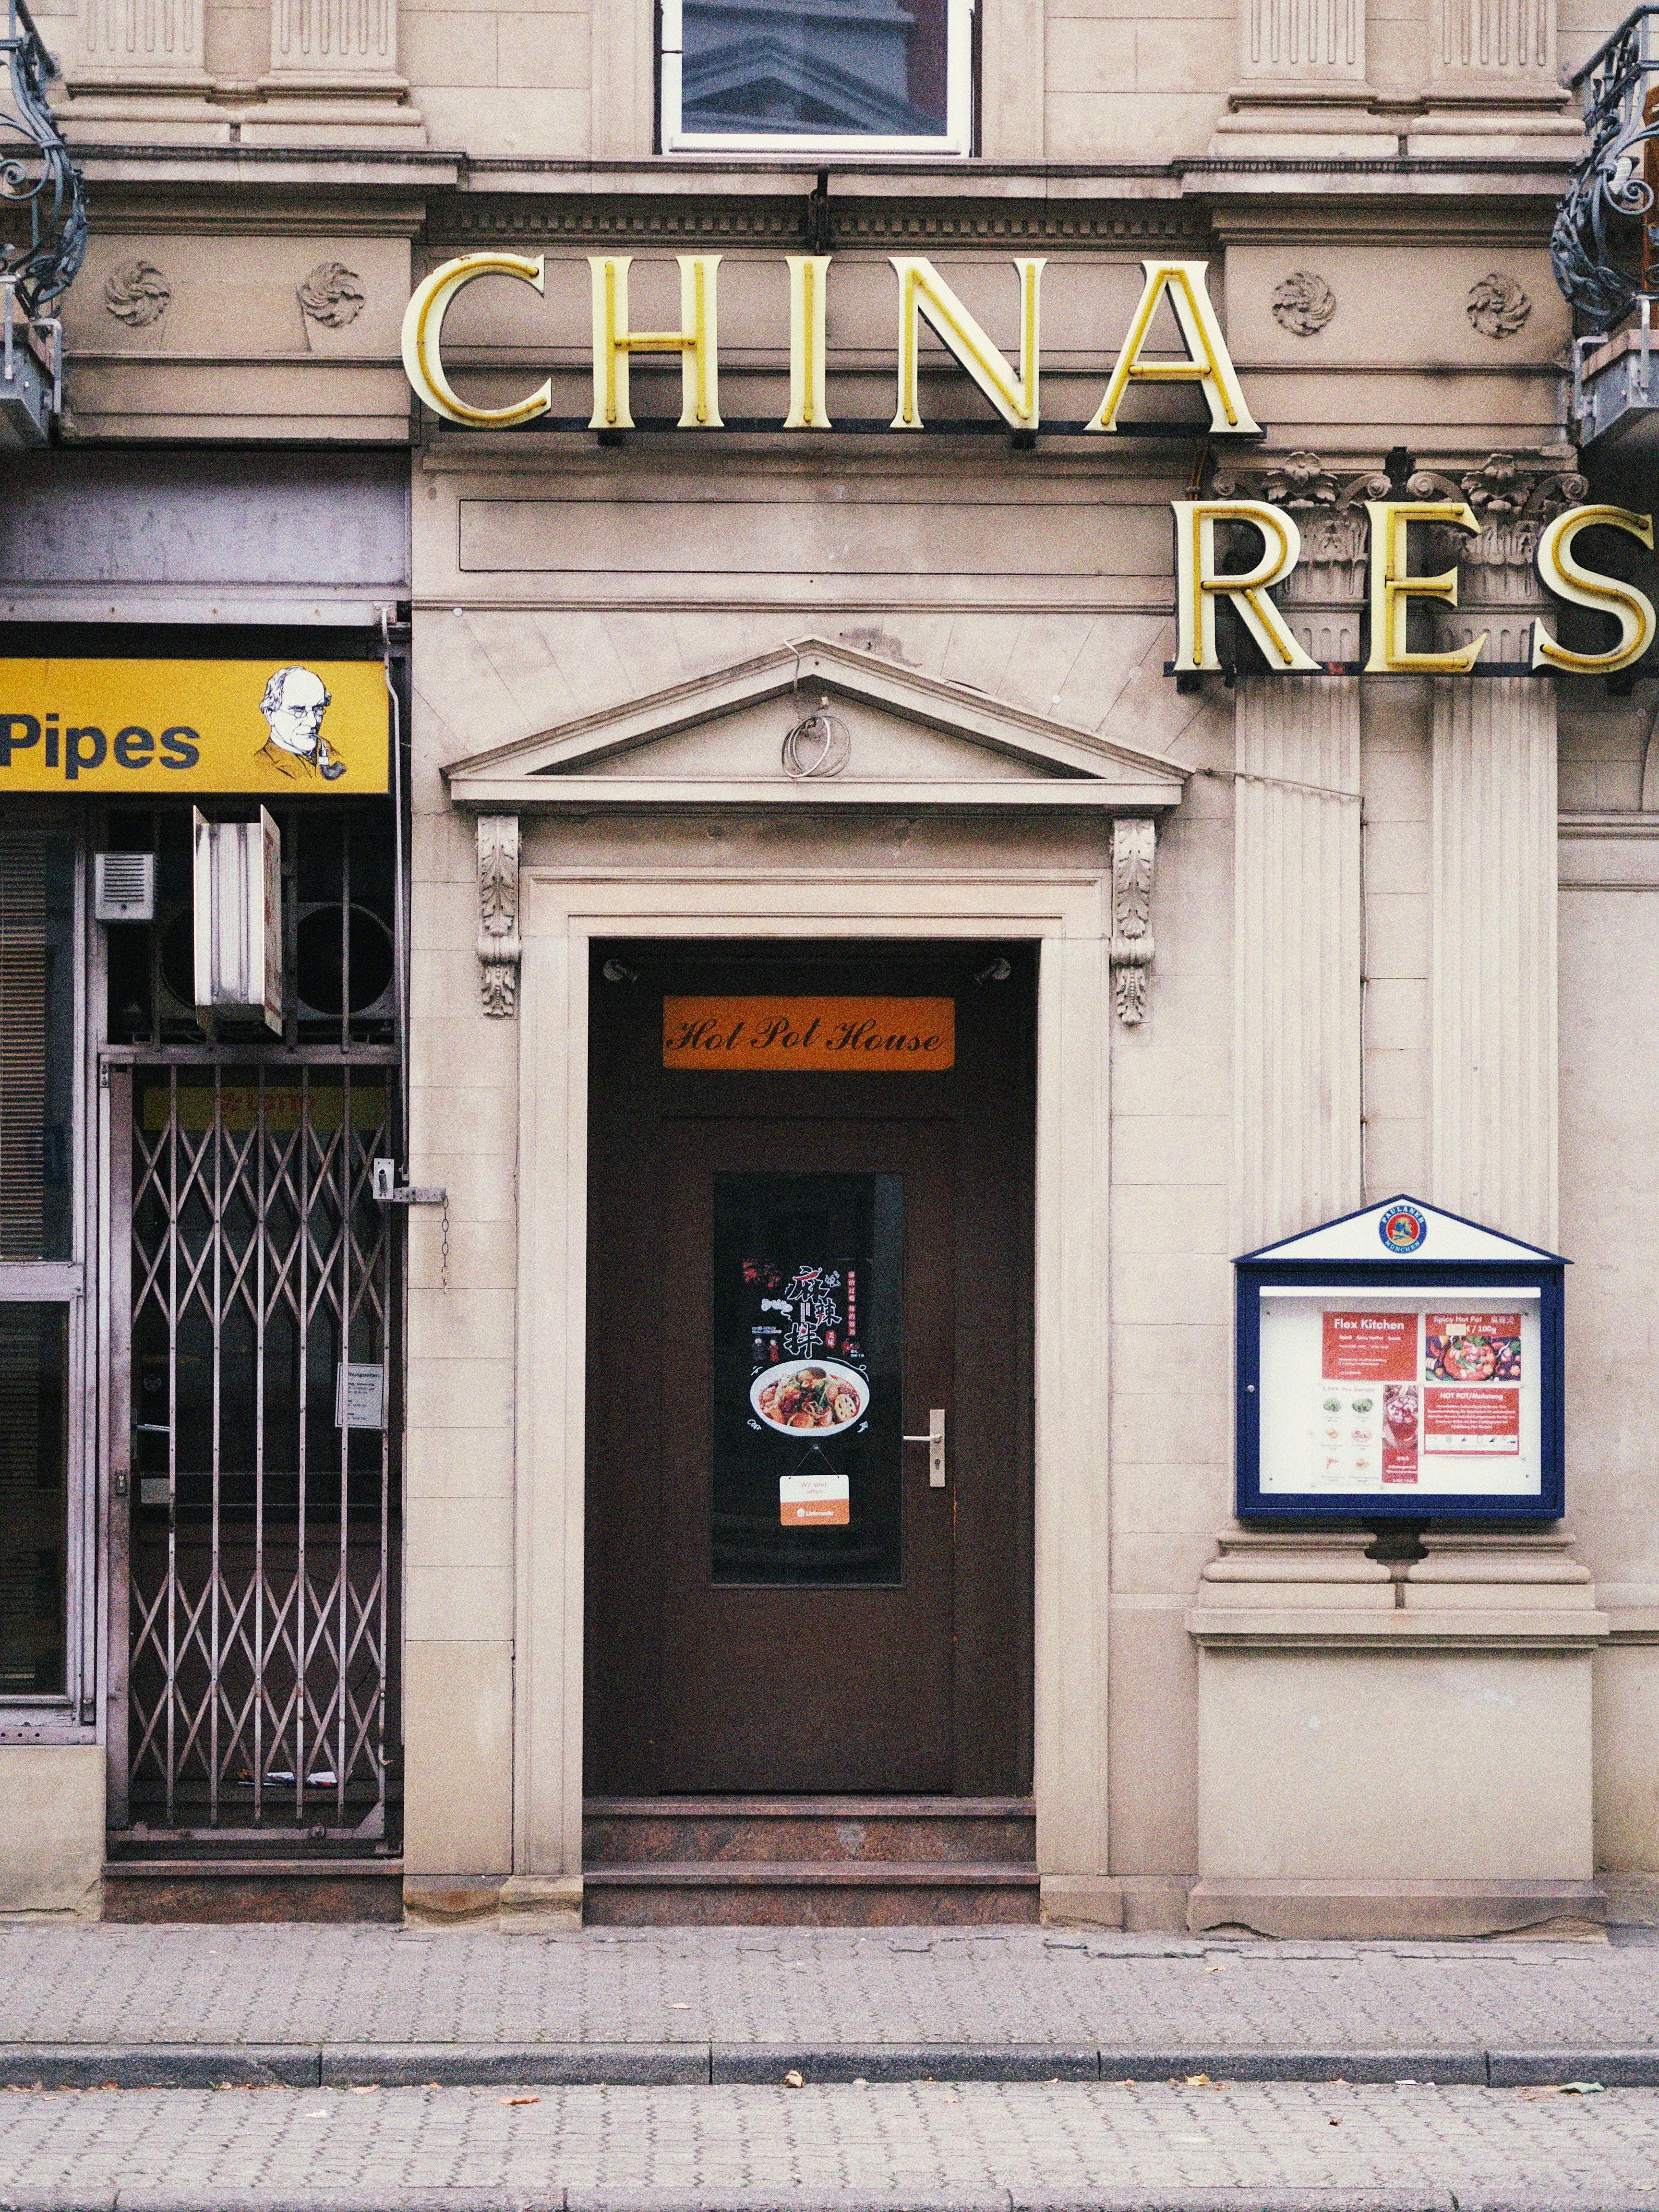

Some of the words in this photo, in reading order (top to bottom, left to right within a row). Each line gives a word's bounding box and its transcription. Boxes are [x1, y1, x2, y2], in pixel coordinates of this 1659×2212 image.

[401, 252, 1262, 433] CHINA
[1171, 500, 1657, 673] RES
[0, 713, 200, 780] Pipes
[666, 1018, 745, 1050] Hot
[750, 1016, 822, 1048] Pot
[826, 1019, 949, 1051] House
[1382, 1206, 1425, 1223] PAULANER
[1334, 1318, 1358, 1329] Flex
[1360, 1319, 1405, 1330] Kitchen
[1478, 1325, 1497, 1334] 100g
